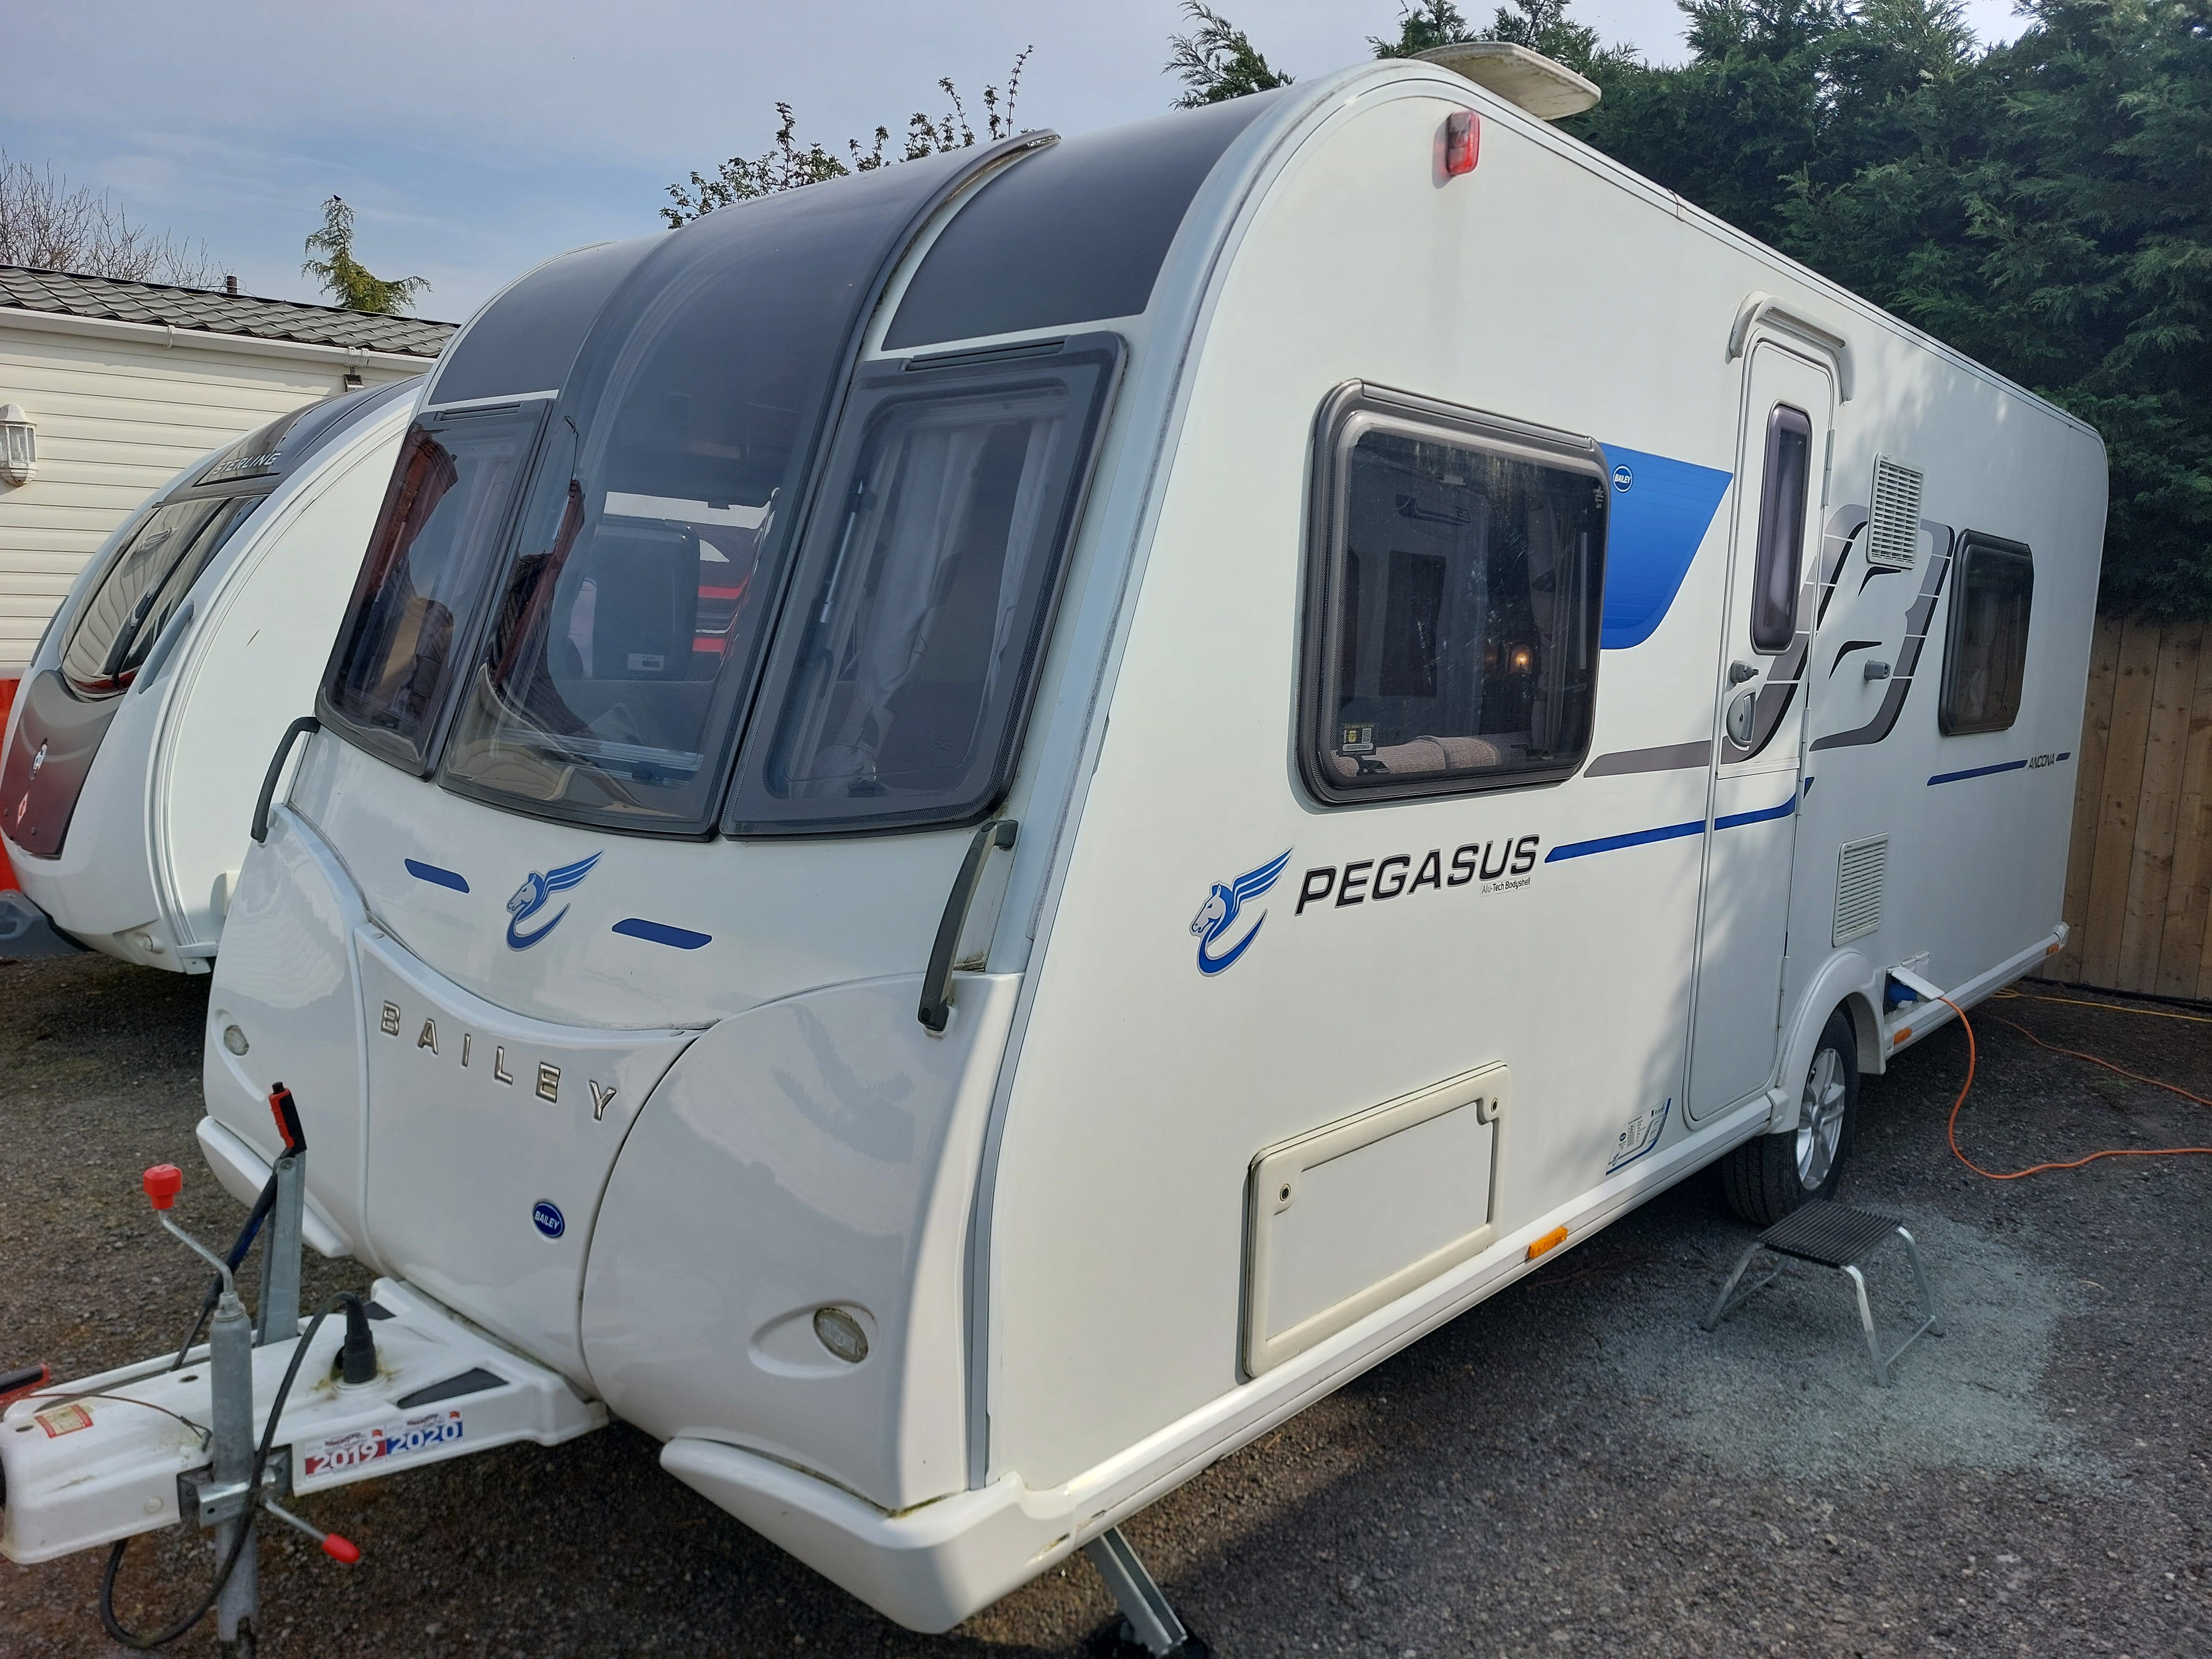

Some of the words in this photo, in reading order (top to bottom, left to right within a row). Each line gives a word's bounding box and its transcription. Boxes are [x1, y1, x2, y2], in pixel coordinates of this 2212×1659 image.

[212, 453, 282, 475] STERLING
[1615, 474, 1631, 484] BAILEY
[2028, 753, 2055, 770] ANCONA
[1294, 834, 1540, 917] PEGASUS
[1482, 882, 1504, 894] Alu-Tech
[1505, 877, 1530, 889] Bodyshell
[381, 1000, 617, 1121] BAILEY
[535, 1211, 560, 1230] BAILEY
[314, 1439, 379, 1474] 2019
[390, 1423, 459, 1455] 2020
